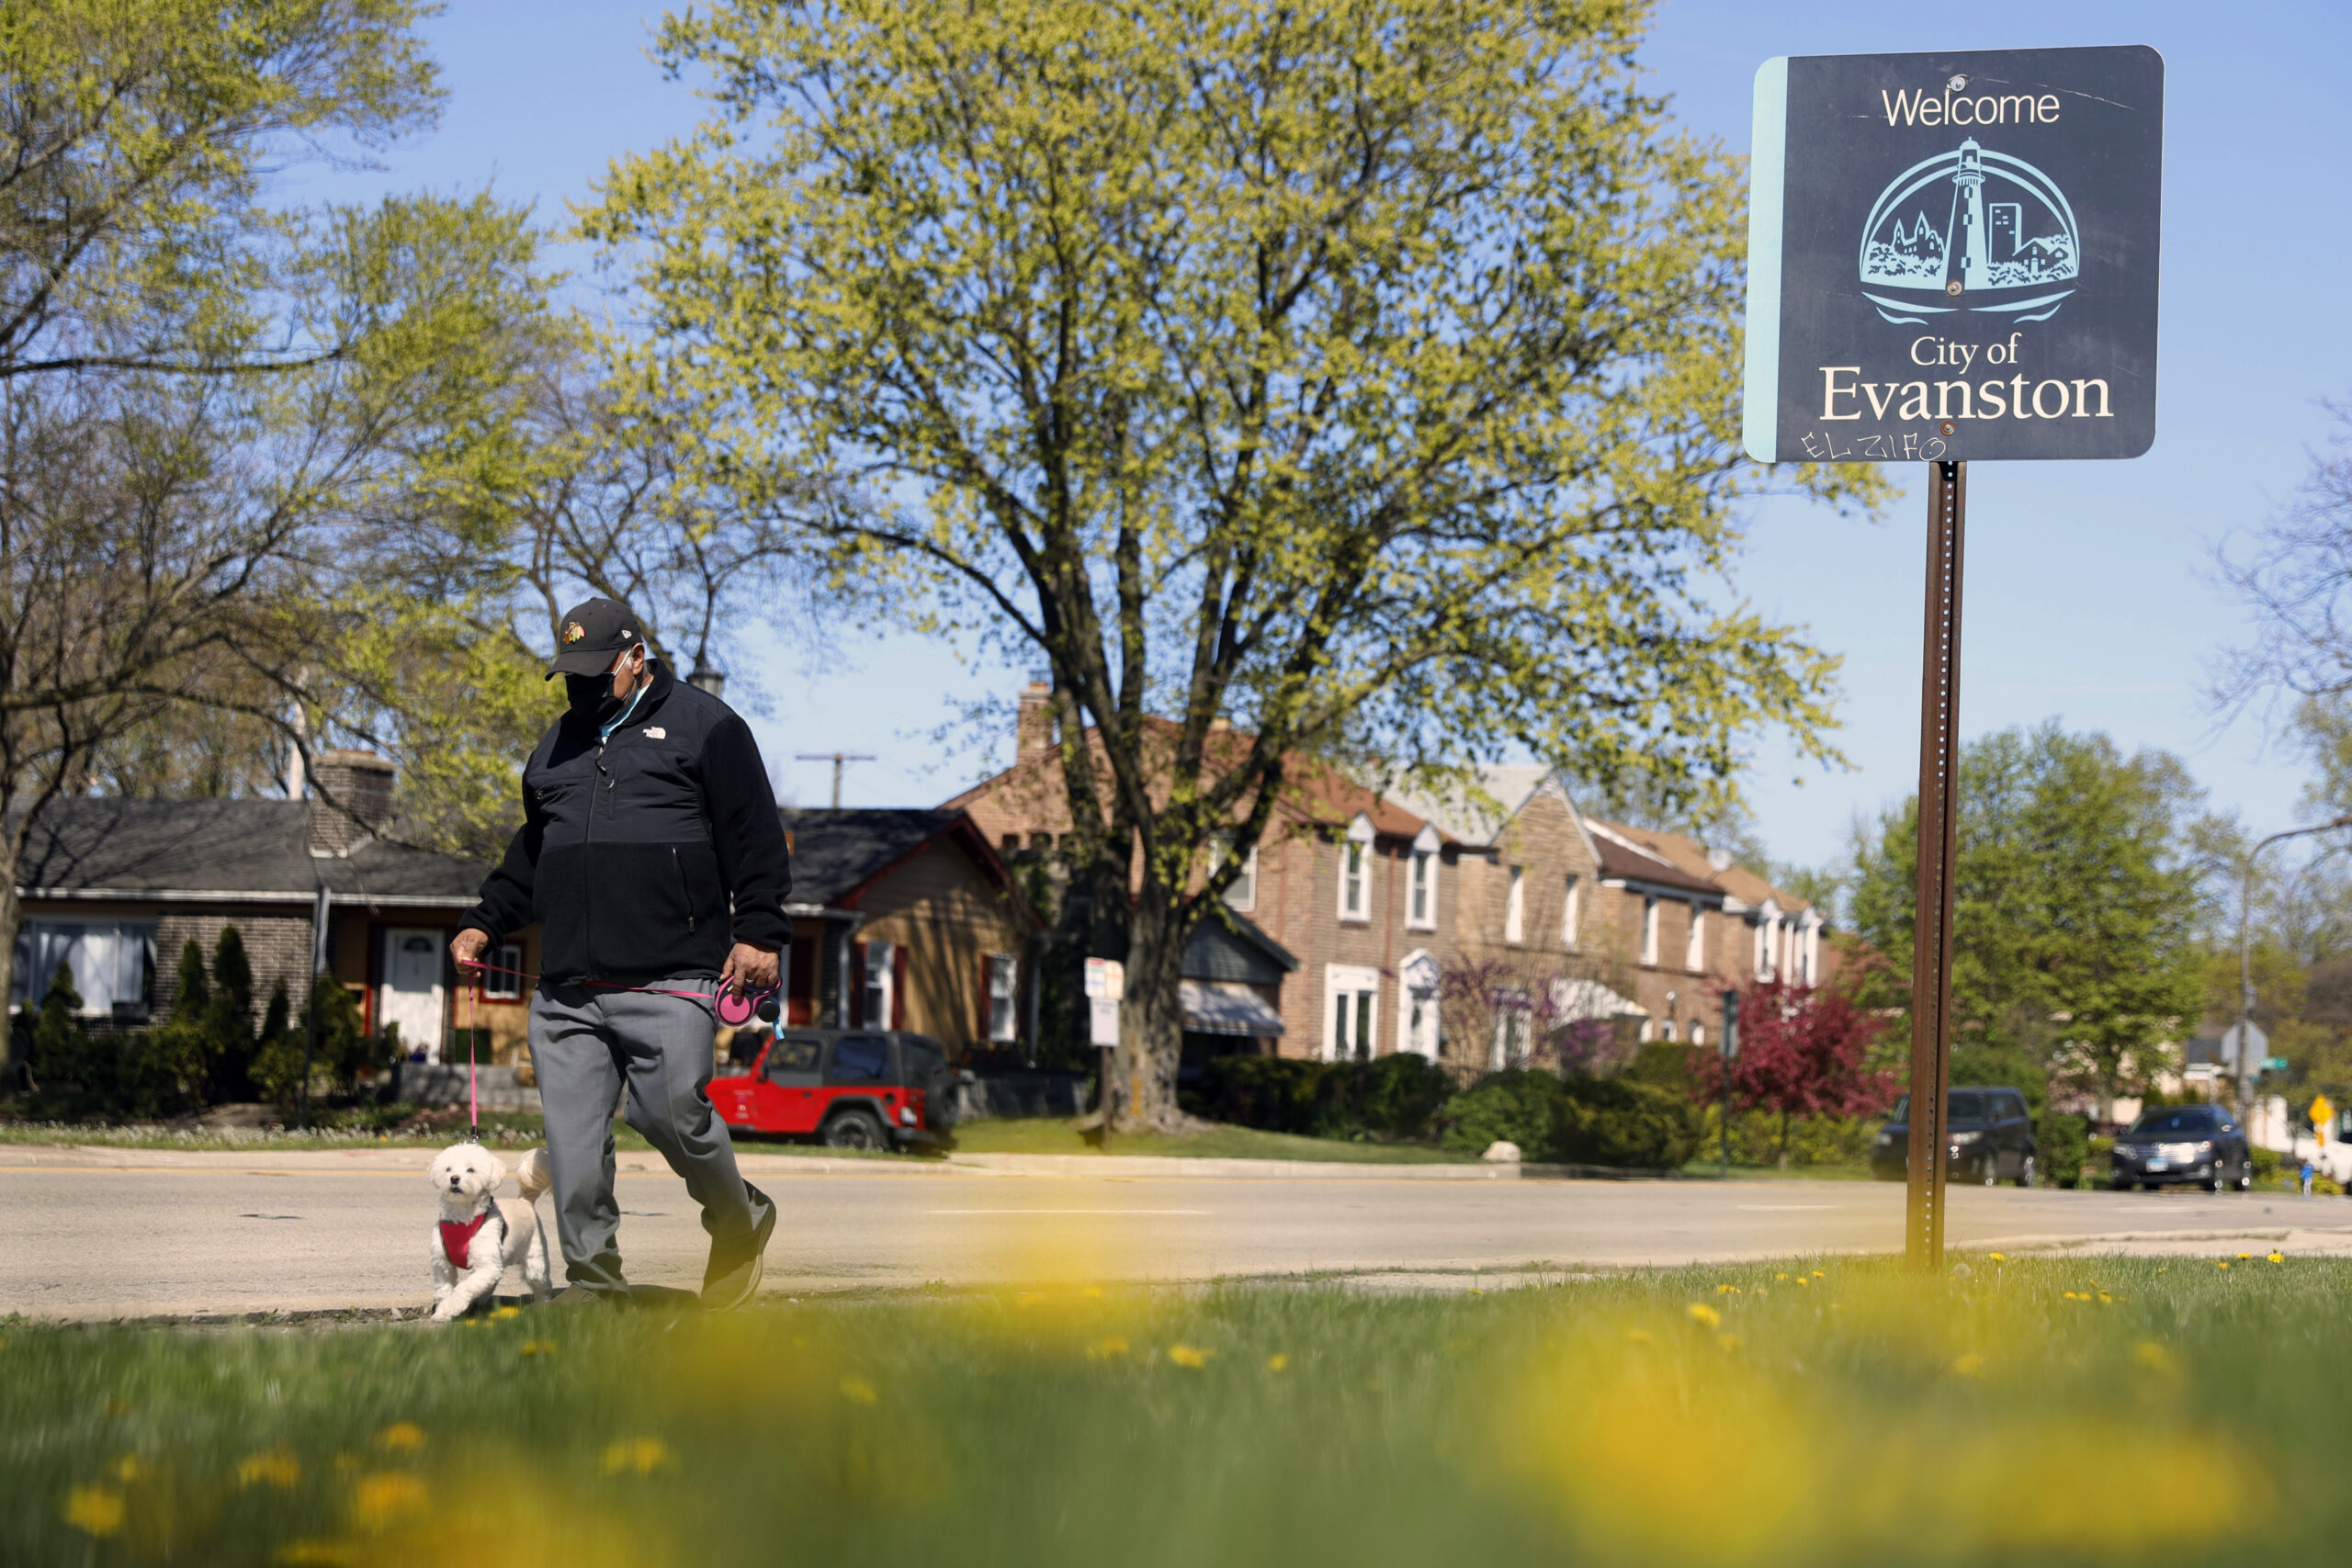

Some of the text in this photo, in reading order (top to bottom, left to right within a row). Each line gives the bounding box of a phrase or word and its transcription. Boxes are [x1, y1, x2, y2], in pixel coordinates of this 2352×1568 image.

[1882, 86, 2060, 126] Welcome
[1910, 333, 2022, 374] City of
[1818, 367, 2114, 421] Evanston
